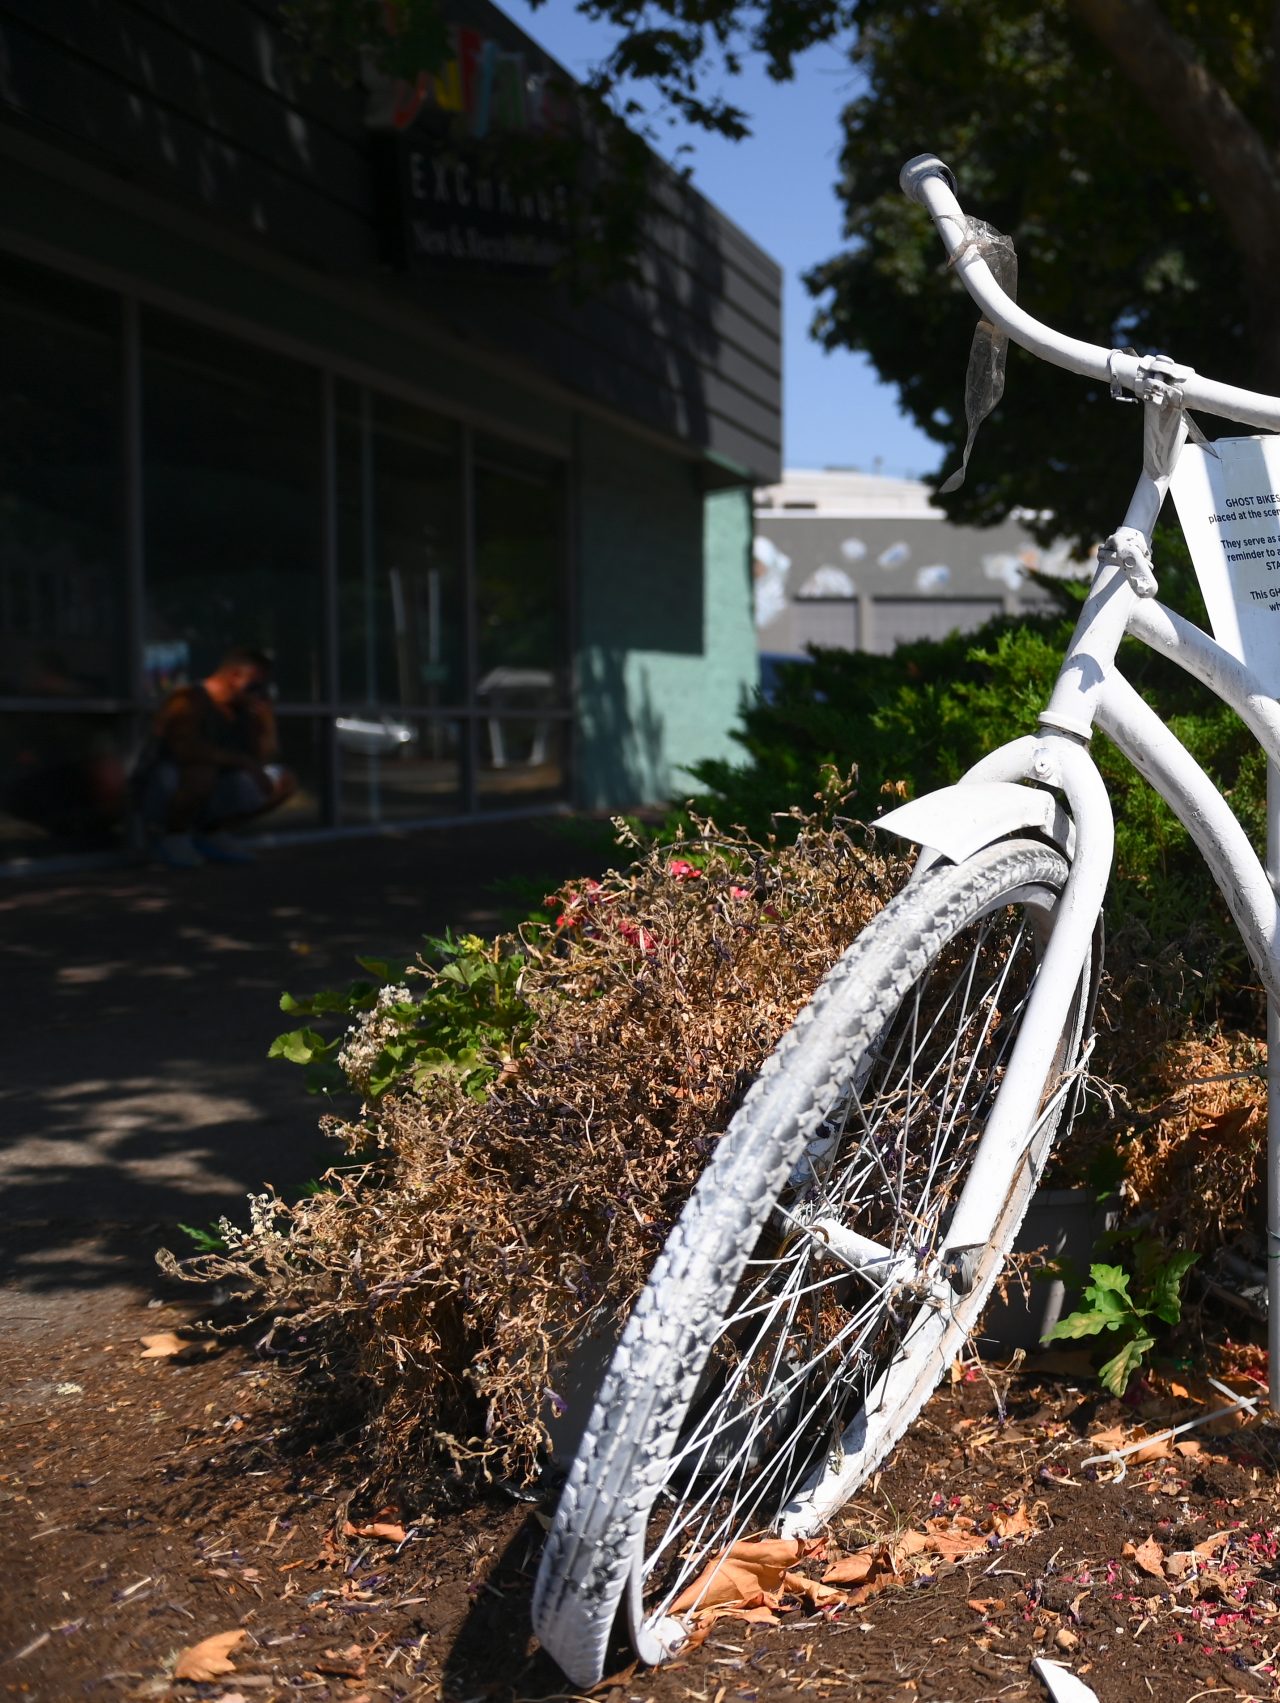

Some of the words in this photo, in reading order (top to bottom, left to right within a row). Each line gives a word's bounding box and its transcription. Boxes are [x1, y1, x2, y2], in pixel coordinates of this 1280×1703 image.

[1226, 496, 1254, 508] GHOST
[1208, 512, 1236, 524] placed
[1238, 511, 1247, 520] at
[1248, 510, 1262, 518] the
[1220, 539, 1241, 549] They
[1243, 536, 1266, 546] serve
[1267, 536, 1276, 544] as
[1227, 550, 1264, 562] reminder
[1266, 549, 1276, 557] to
[1250, 590, 1268, 600] This
